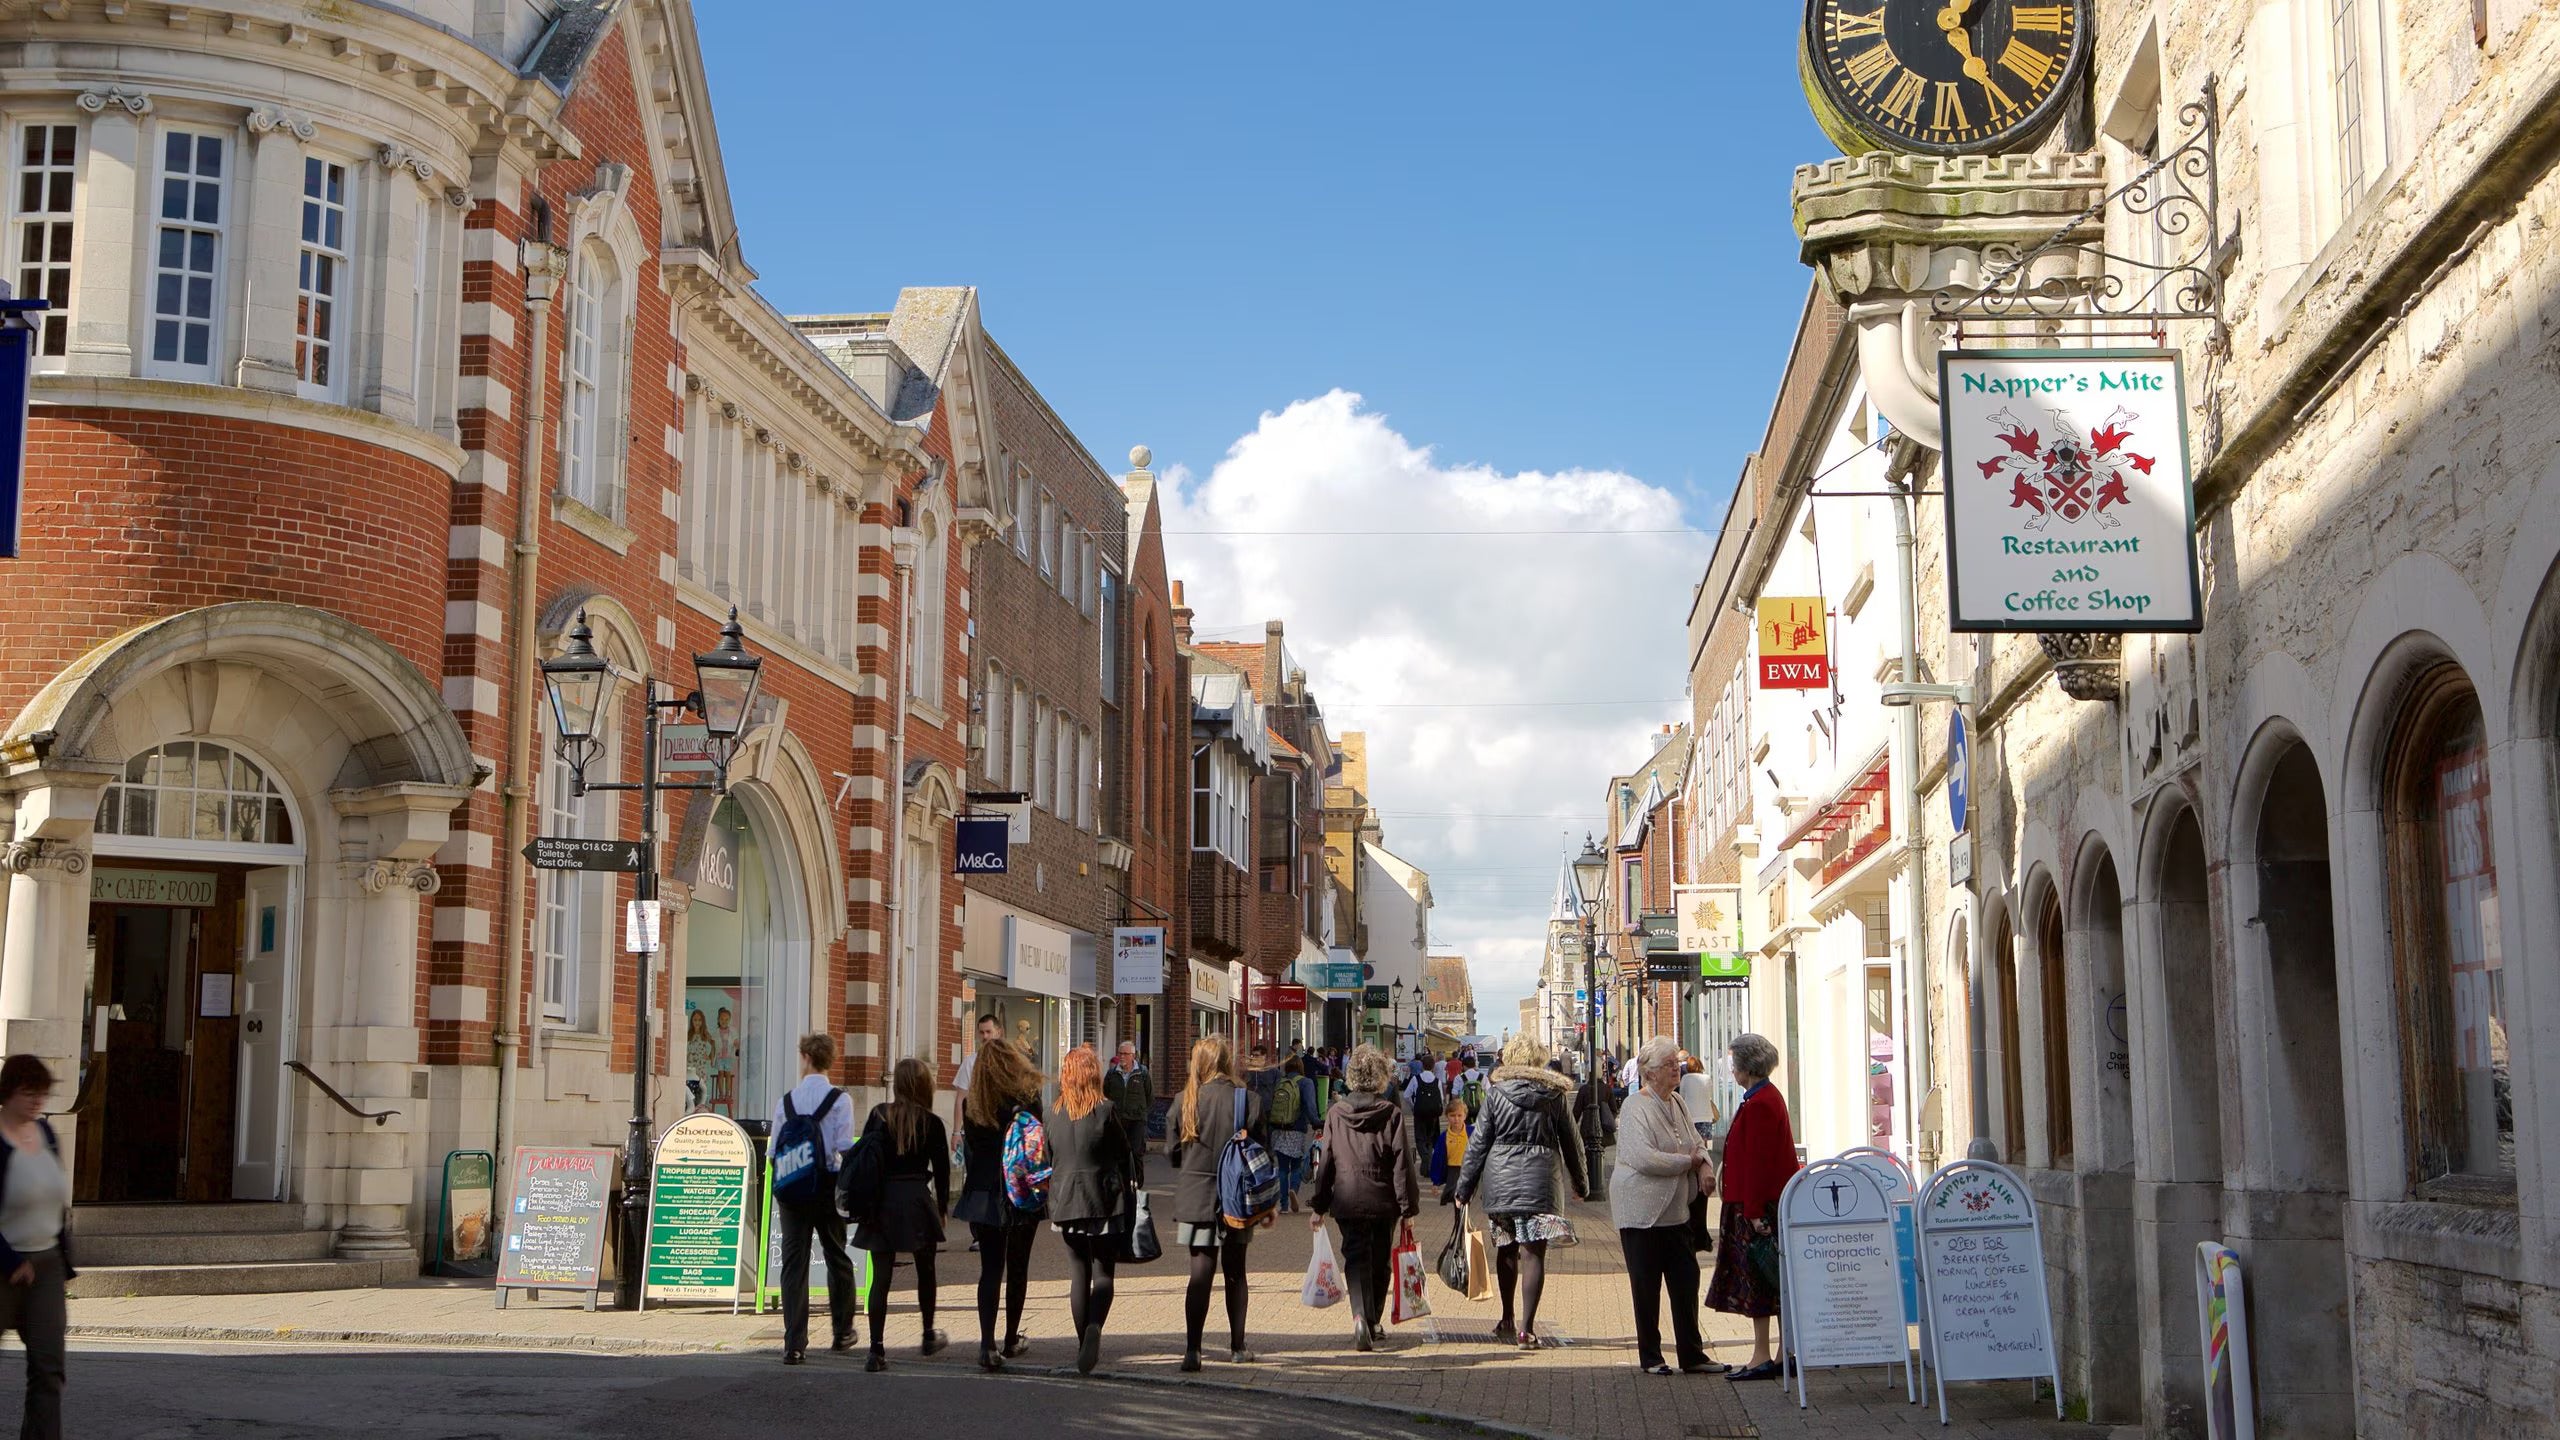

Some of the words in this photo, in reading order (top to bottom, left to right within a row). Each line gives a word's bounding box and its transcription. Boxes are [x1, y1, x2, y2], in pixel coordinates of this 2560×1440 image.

[1961, 371, 2088, 398] Napper's
[2099, 369, 2164, 392] Mite
[2001, 535, 2140, 556] Restaurant
[2051, 564, 2100, 583] and
[2004, 589, 2080, 613] Coffee
[2088, 588, 2151, 614] Shop
[1767, 663, 1822, 680] EWM
[537, 840, 553, 849] Bus
[555, 841, 580, 851] Stops
[538, 849, 565, 858] Toilets
[959, 852, 1004, 868] M&Co.
[537, 858, 556, 867] Post
[557, 858, 583, 868] Office
[116, 874, 156, 900] CAFÉ
[167, 880, 212, 903] FOOD
[1687, 936, 1731, 949] EAST
[1020, 943, 1042, 969] NEW
[1045, 950, 1067, 976] LOOK
[676, 1127, 733, 1137] Shoetrees
[776, 1141, 815, 1181] NIKE
[662, 1167, 697, 1175] TROPHIES
[1988, 1178, 2015, 1206] Mite
[1935, 1216, 1969, 1224] Restaurant
[2003, 1213, 2019, 1221] Shop
[1807, 1233, 1874, 1245] Dorchester
[1948, 1236, 1977, 1250] OPEN
[1983, 1236, 2005, 1249] FOR
[669, 1248, 719, 1256] ACCESSORIES
[1803, 1246, 1881, 1260] Chiropractic
[1942, 1253, 2010, 1265] BREAKFASTS
[1826, 1262, 1861, 1273] Clinic
[1937, 1267, 1978, 1278] MORNING
[1984, 1264, 2029, 1277] COFFEE
[1965, 1279, 2007, 1290] LUNCHES
[1942, 1294, 1995, 1304] AFTERNOON
[2000, 1290, 2019, 1301] TEA
[1955, 1307, 1986, 1317] CREAM
[1989, 1305, 2016, 1315] TEAS
[1944, 1330, 1996, 1342] EVERYTHING
